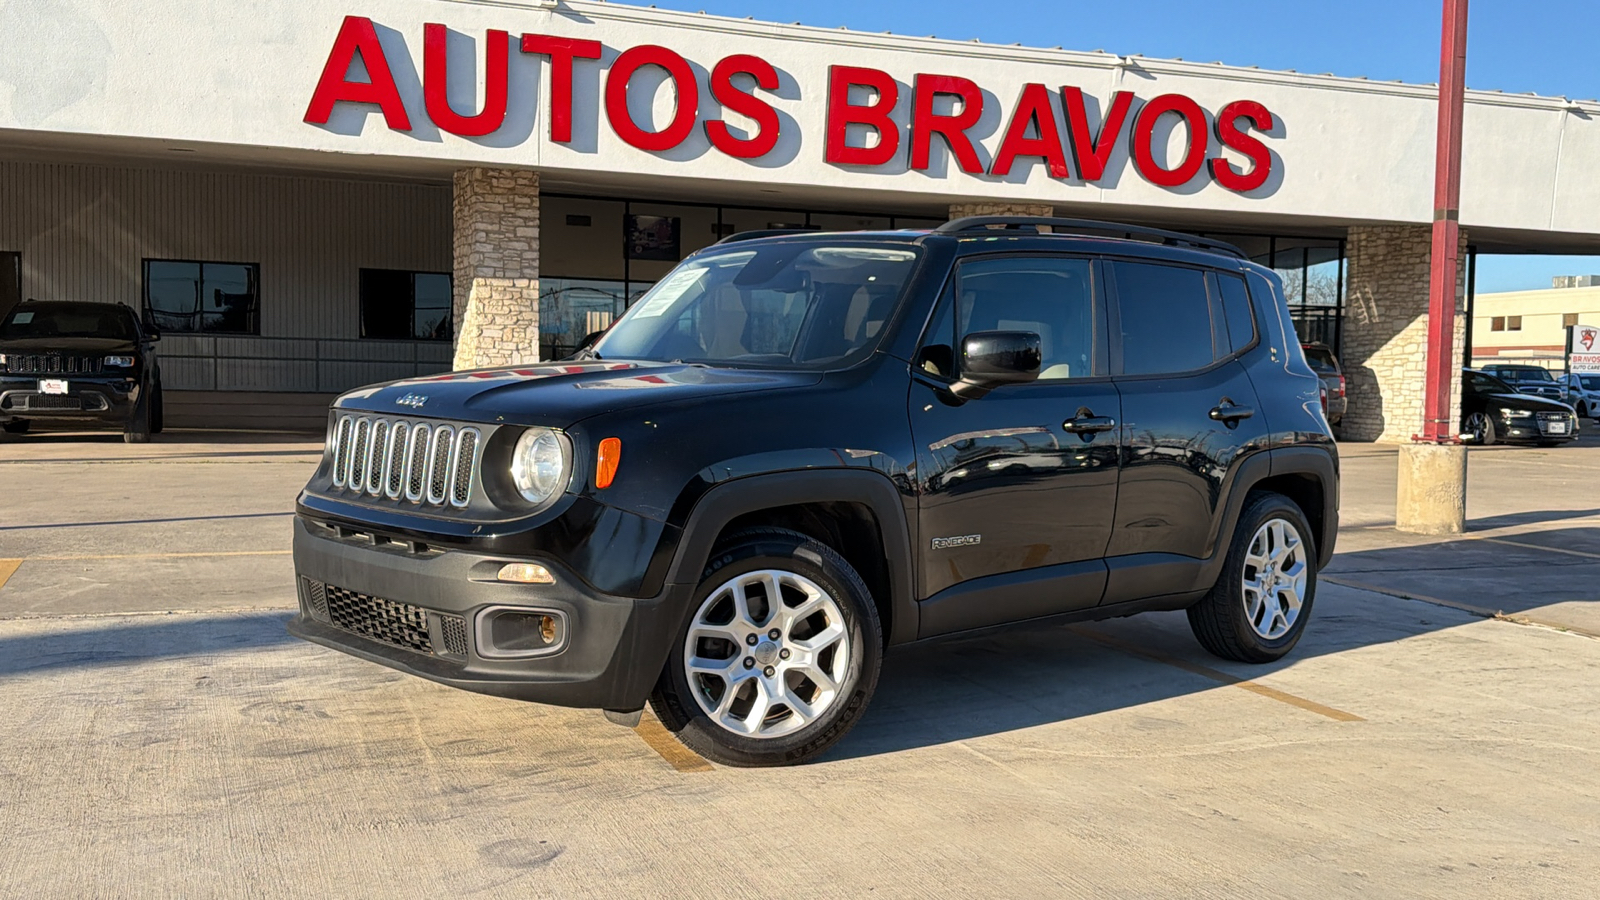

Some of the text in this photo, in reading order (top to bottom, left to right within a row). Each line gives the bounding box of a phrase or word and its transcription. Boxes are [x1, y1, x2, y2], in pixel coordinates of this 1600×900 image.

[303, 15, 1274, 192] AUTOS BRAVOS
[395, 392, 429, 409] Jeep
